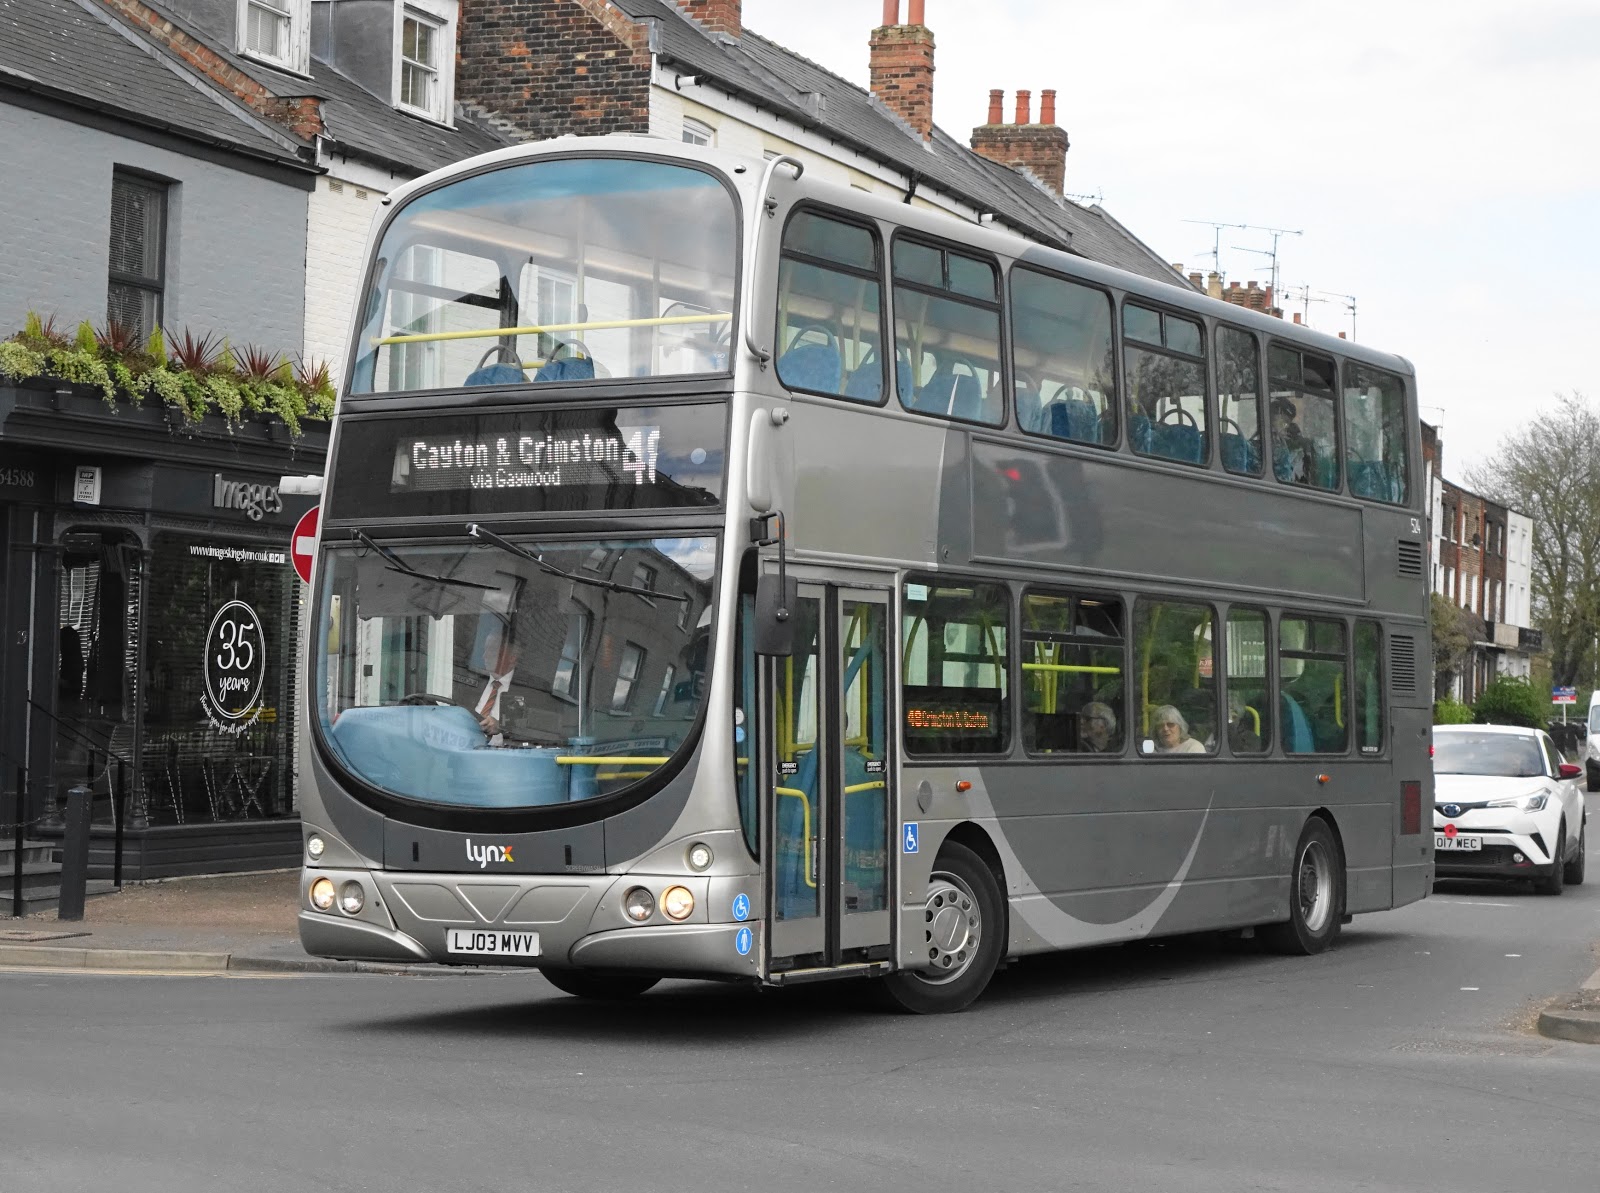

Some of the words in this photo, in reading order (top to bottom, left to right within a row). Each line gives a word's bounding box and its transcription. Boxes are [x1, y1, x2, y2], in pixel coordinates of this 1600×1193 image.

[413, 440, 488, 469] Gayton
[497, 438, 510, 465] &
[519, 434, 619, 464] Grimston
[470, 469, 493, 488] via
[496, 465, 561, 487] Gaywood
[214, 473, 283, 521] Images
[217, 620, 254, 670] 35
[219, 676, 250, 702] years
[466, 838, 515, 869] lynx
[1456, 838, 1477, 849] WEC
[454, 932, 497, 951] LJ03
[501, 934, 533, 953] MVV
